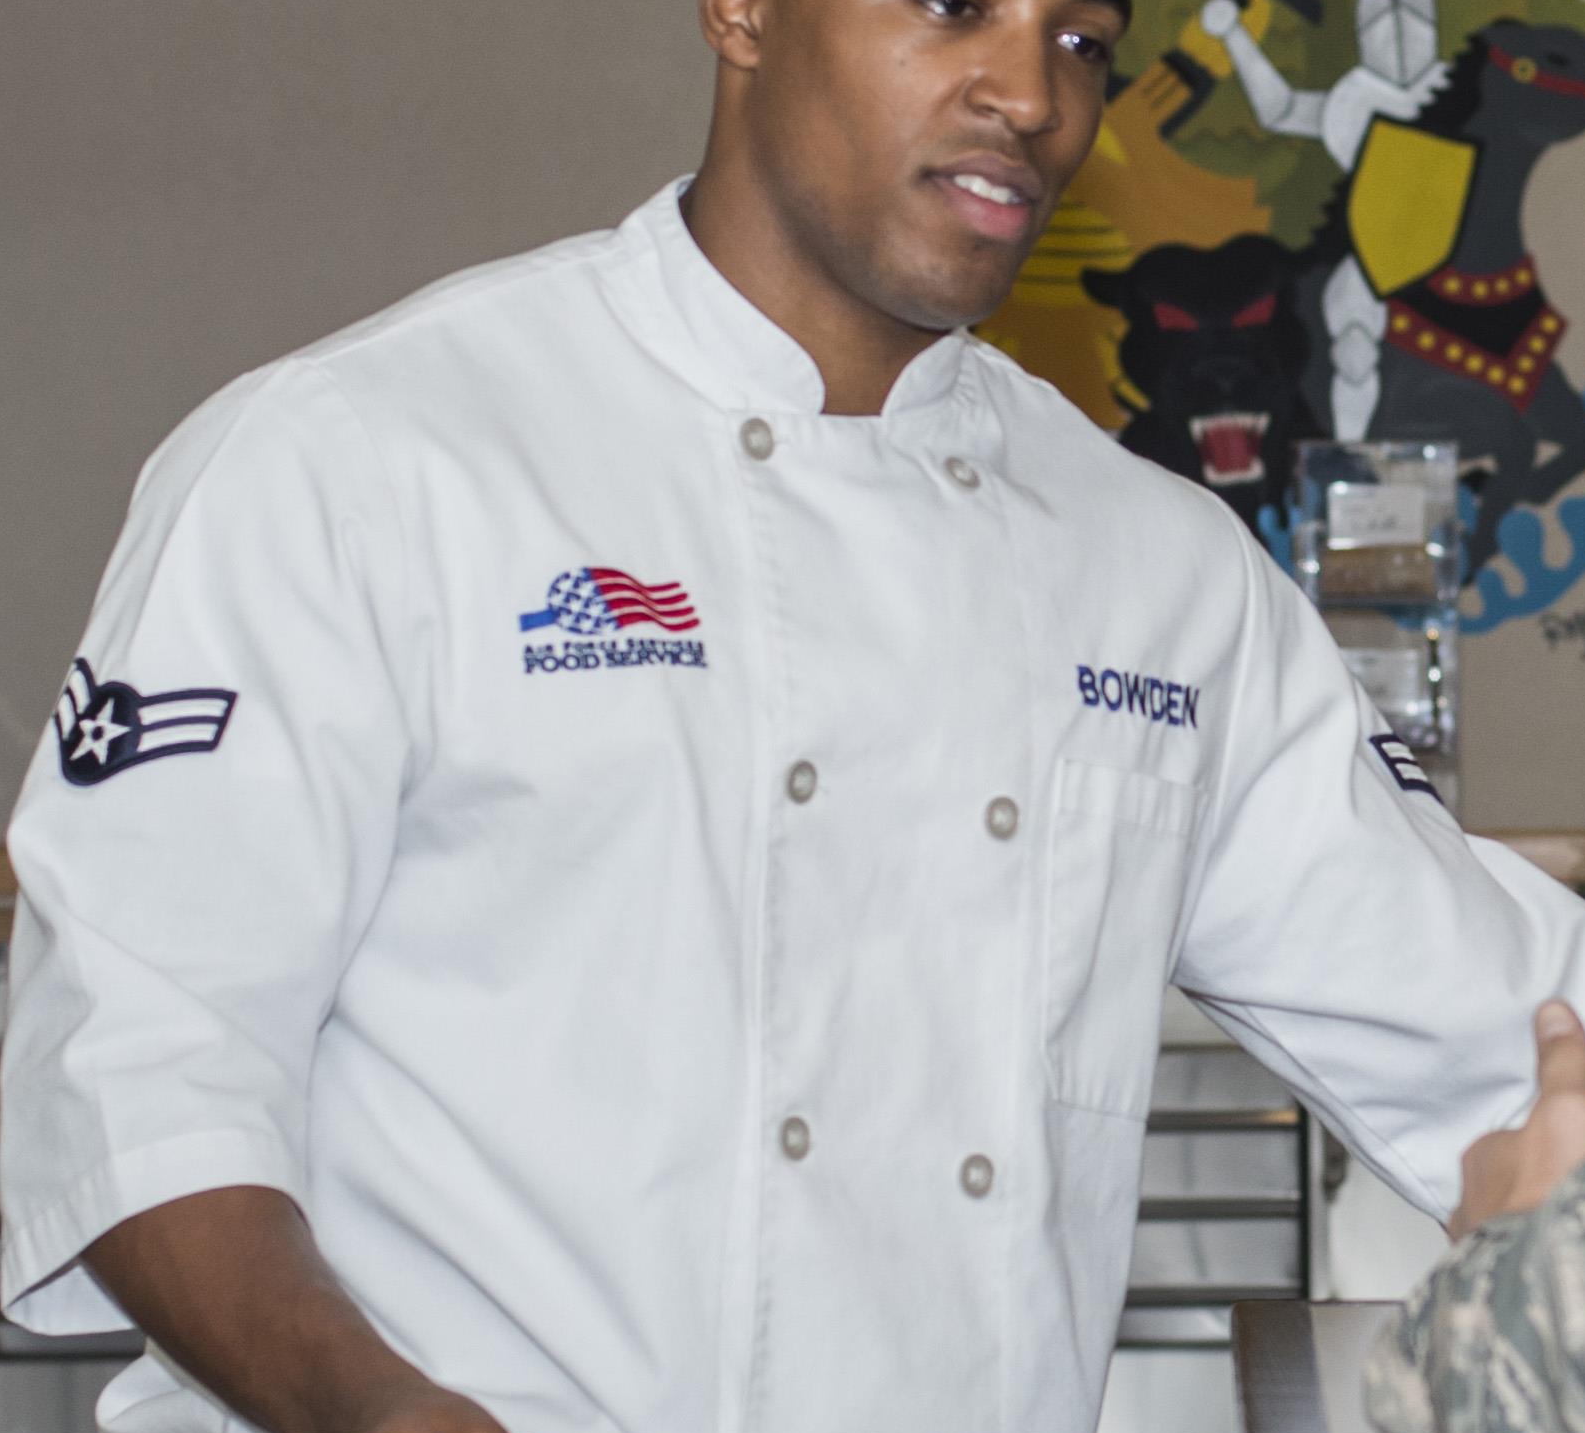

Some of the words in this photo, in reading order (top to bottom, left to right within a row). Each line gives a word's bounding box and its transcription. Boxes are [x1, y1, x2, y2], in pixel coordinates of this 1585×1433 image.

[524, 653, 601, 674] FOOD
[606, 651, 707, 667] SERVICE
[1076, 664, 1200, 729] BOWDEN
